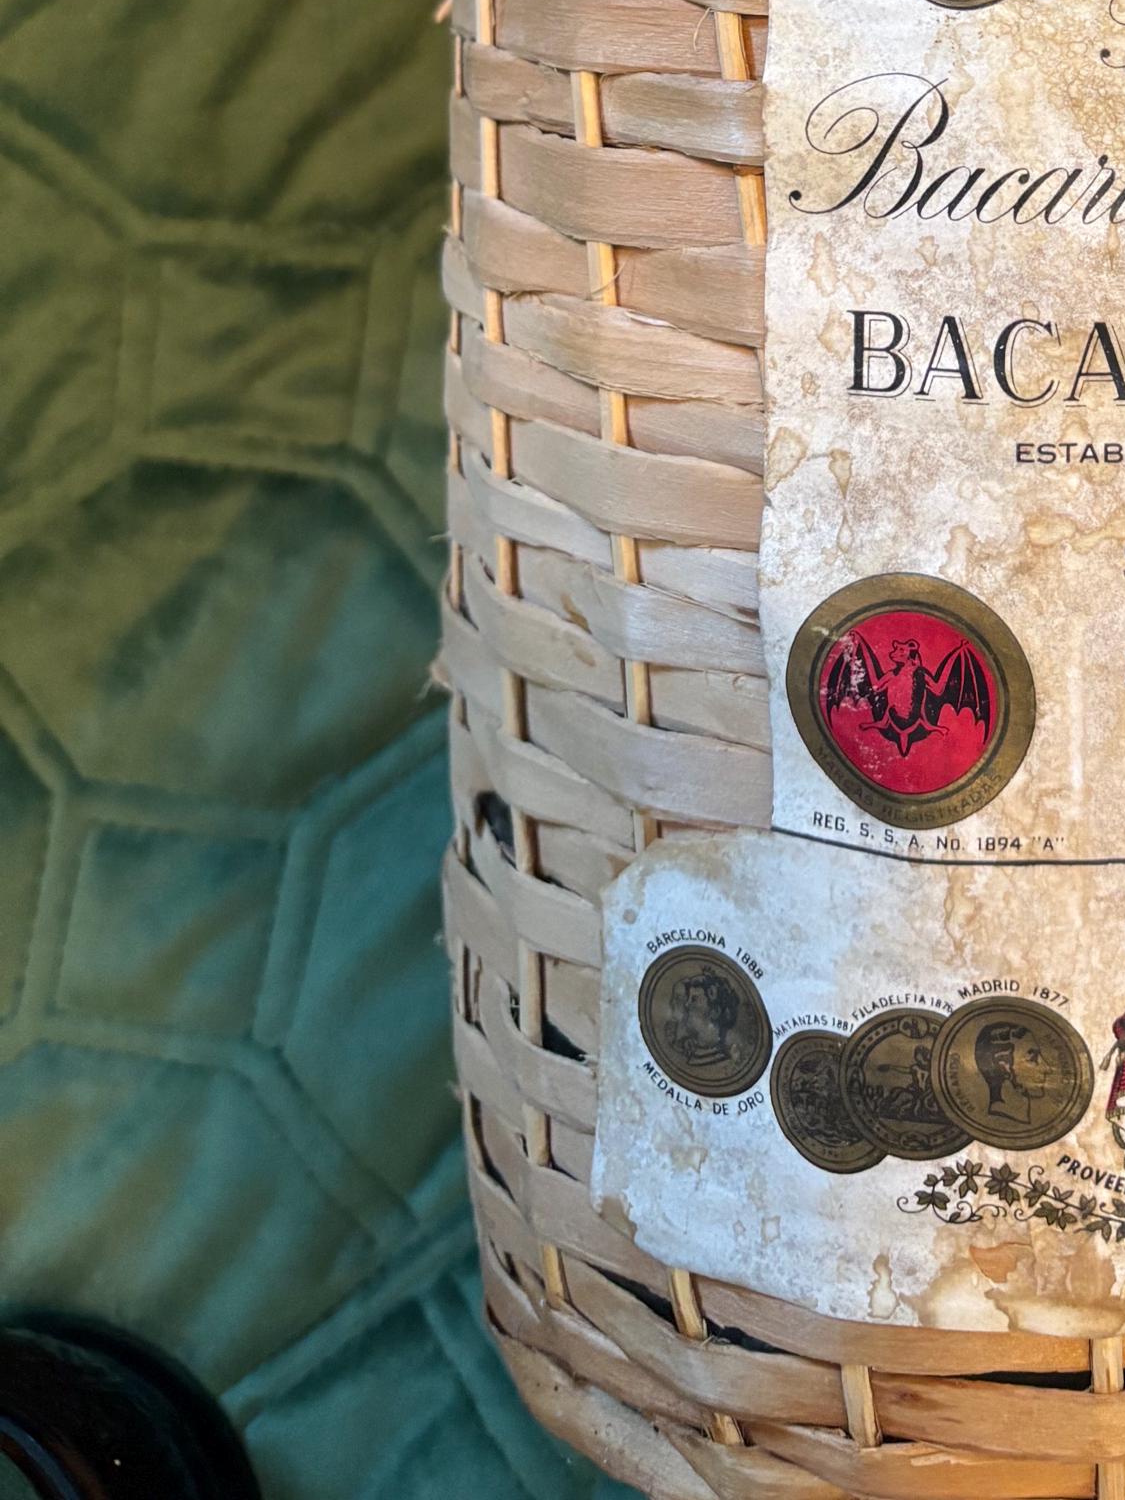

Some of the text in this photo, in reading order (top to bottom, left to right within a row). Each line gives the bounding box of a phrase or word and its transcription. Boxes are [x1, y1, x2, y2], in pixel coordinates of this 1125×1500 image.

[817, 747, 873, 807] MARCAS
[882, 771, 1002, 825] REGISTRADAS
[812, 811, 850, 835] REG.
[859, 822, 875, 839] S.
[909, 834, 925, 850] A.
[936, 835, 966, 851] No.
[977, 836, 1022, 851] 1894
[1032, 836, 1065, 851] "A"
[646, 928, 765, 980] BARCELONA 1888
[851, 993, 927, 1021] FILADELFIA
[957, 979, 1070, 1008] MADRID 1877
[773, 1014, 828, 1038] MATANZAS
[642, 1061, 766, 1116] MEDALLA DE ORO
